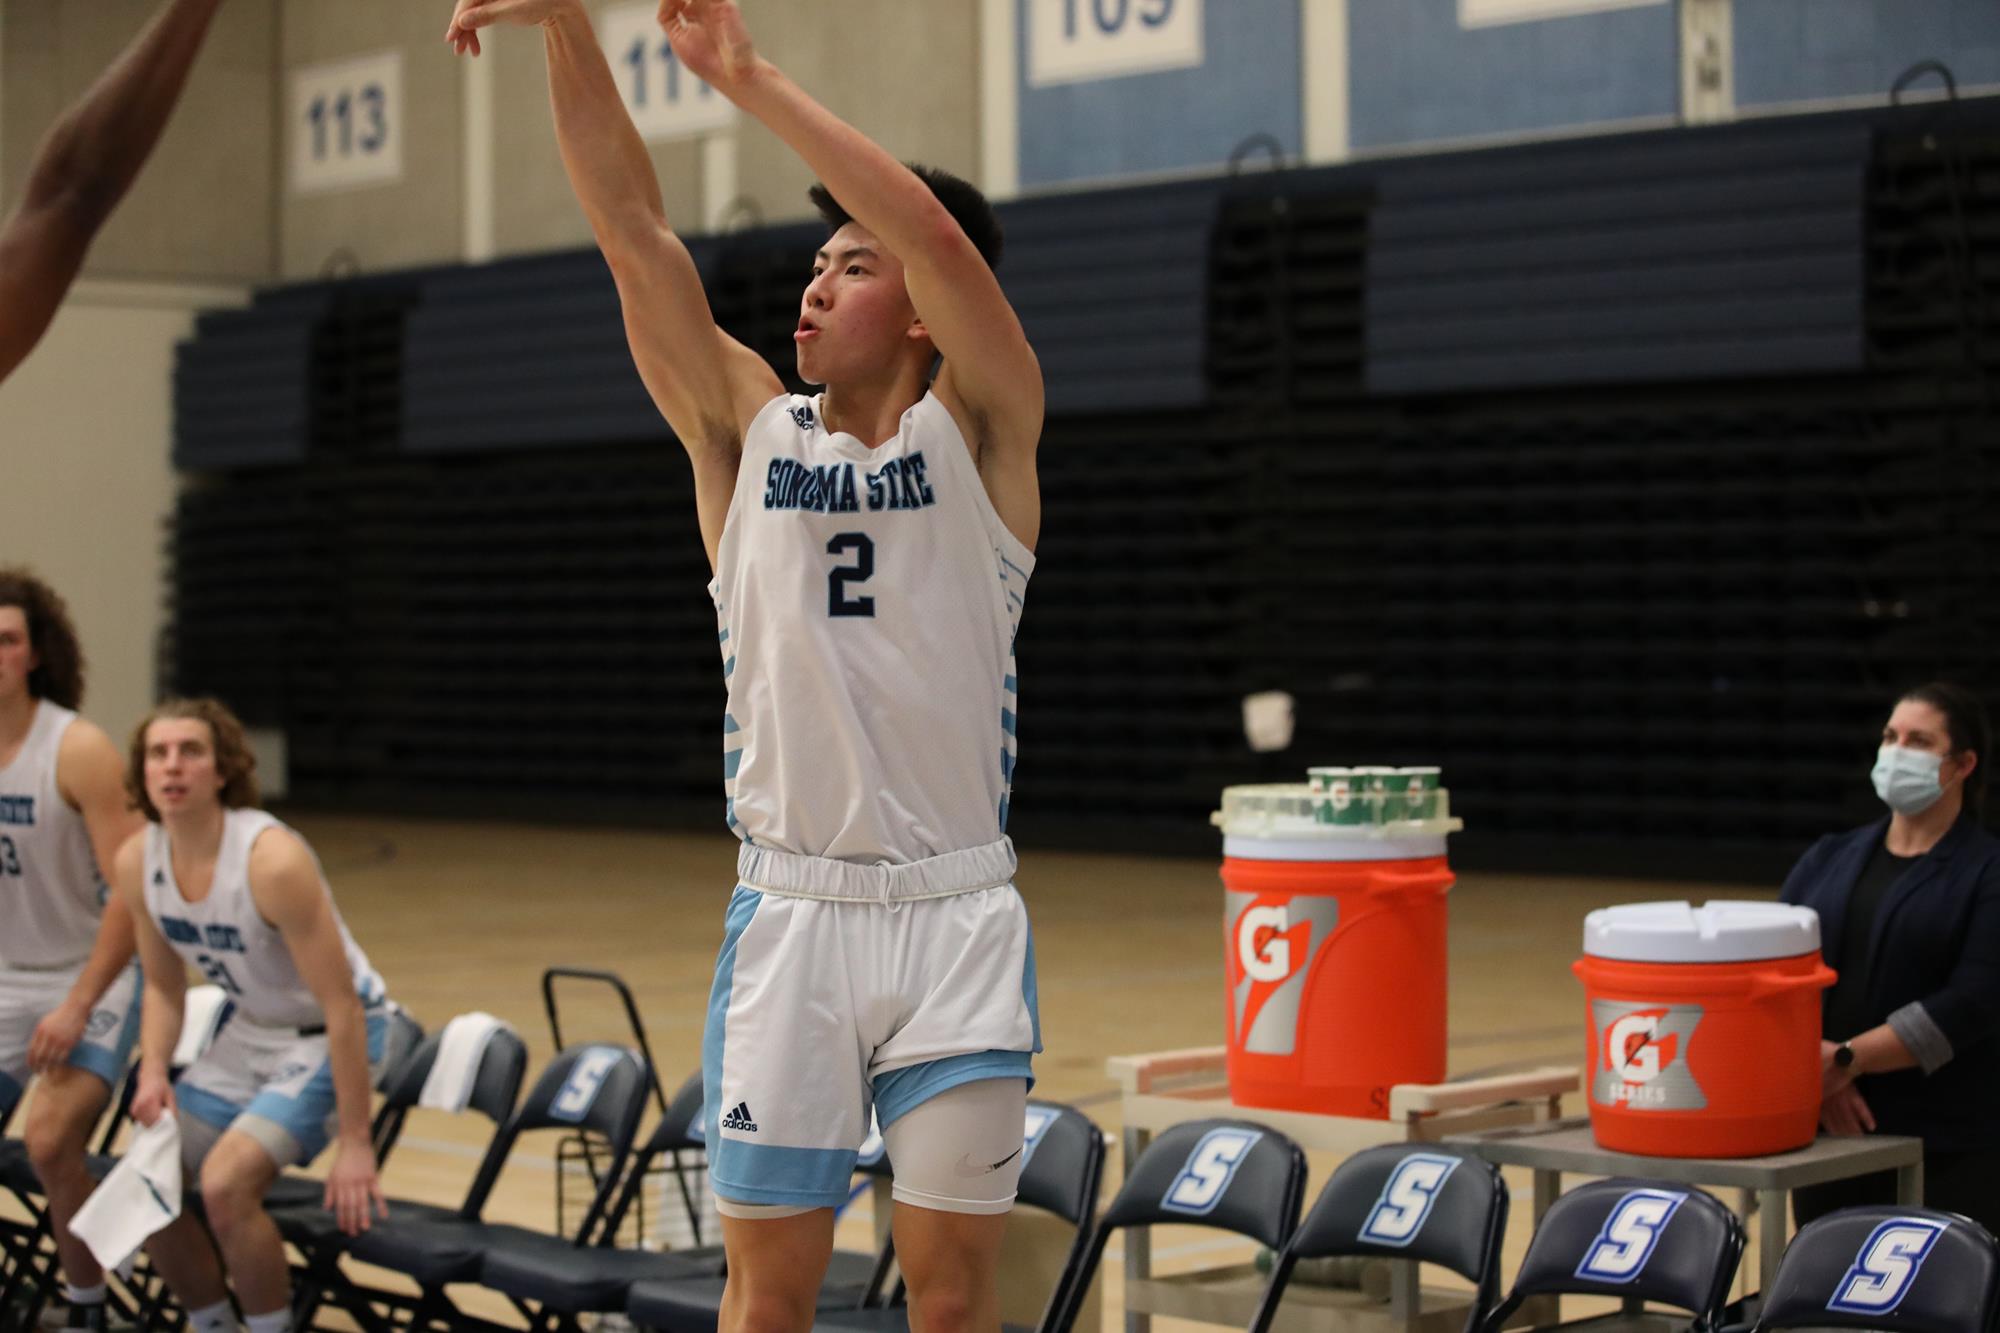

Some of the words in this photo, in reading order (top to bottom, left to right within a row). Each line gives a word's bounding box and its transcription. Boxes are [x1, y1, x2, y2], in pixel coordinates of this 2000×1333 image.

[624, 36, 712, 106] 11
[307, 81, 387, 162] 113
[764, 457, 860, 514] SONOMA
[826, 532, 876, 618] 2
[1239, 904, 1291, 982] G
[1610, 1016, 1660, 1082] G
[722, 1118, 758, 1132] adidas
[1166, 1132, 1257, 1211] S
[1362, 1157, 1456, 1243] S
[1582, 1191, 1680, 1279] S
[1834, 1221, 1943, 1311] S
